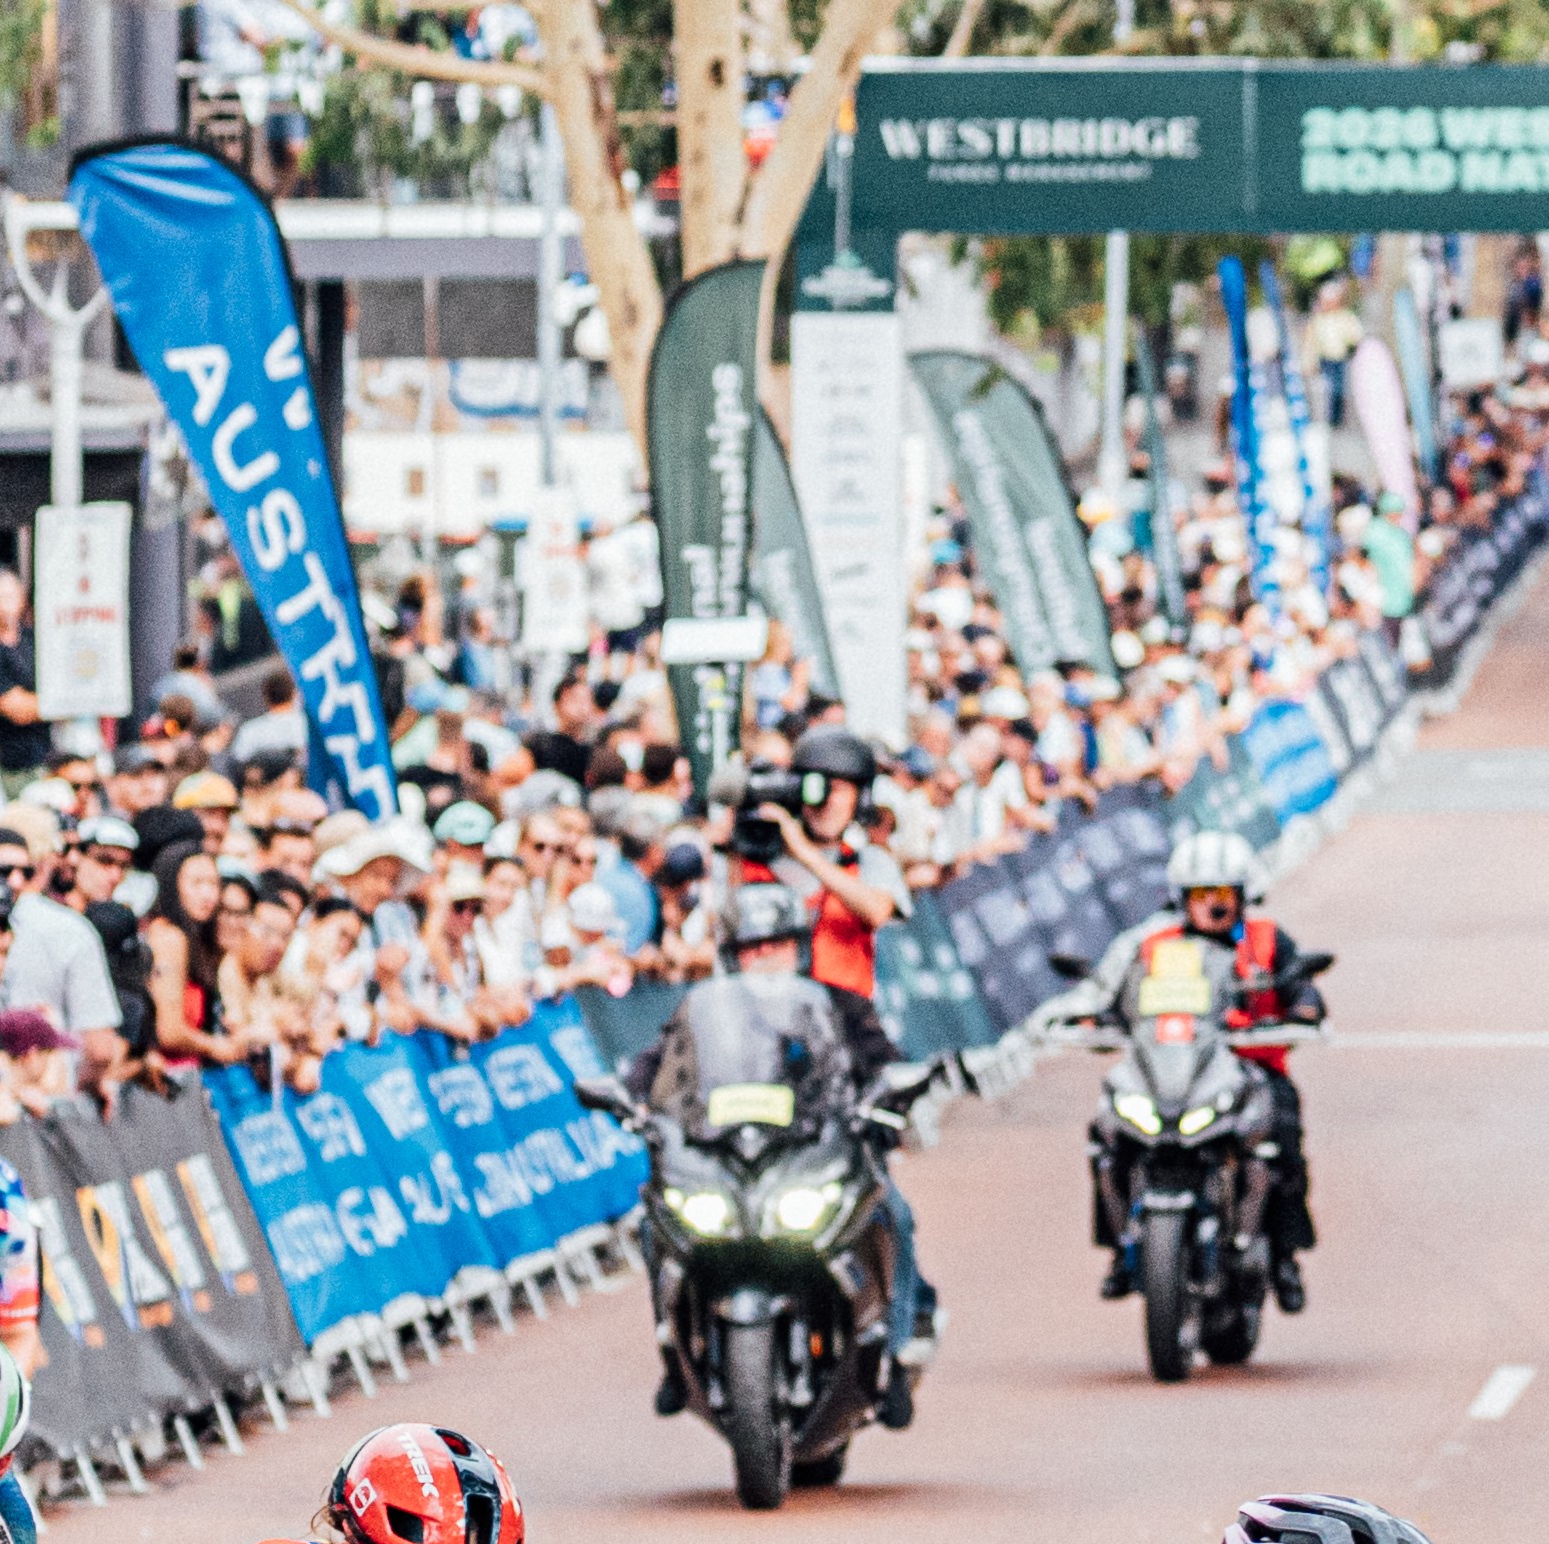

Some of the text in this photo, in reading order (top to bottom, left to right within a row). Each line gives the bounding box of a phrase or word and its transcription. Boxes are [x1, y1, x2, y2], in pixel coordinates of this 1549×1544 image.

[879, 117, 1200, 160] WESTBRIDGE
[1300, 149, 1455, 193] ROAD
[397, 1432, 440, 1499] TREK
